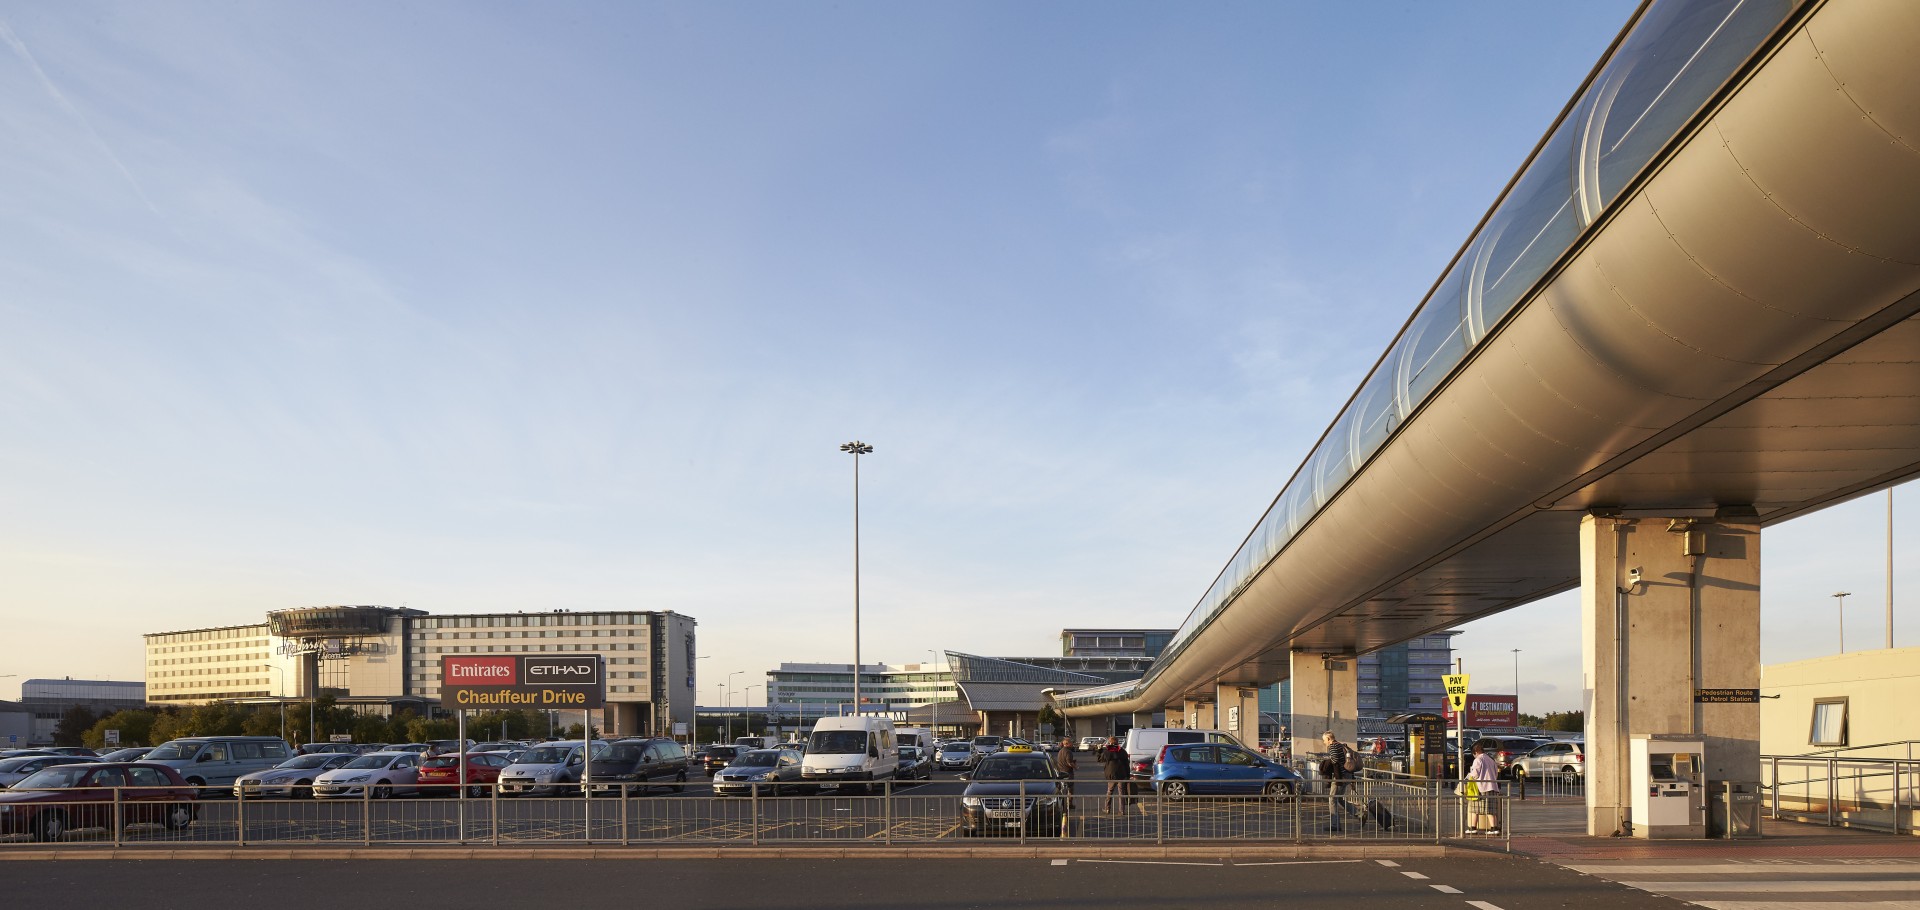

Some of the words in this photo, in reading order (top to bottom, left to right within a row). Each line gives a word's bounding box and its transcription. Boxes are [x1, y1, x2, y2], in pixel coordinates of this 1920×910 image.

[451, 664, 510, 677] Emirates
[530, 665, 591, 675] ETIHAD
[1450, 676, 1462, 685] PAY
[1448, 686, 1465, 695] HERE
[456, 690, 538, 704] Chauffeur
[543, 690, 586, 704] Drive
[1471, 702, 1477, 711] 47
[1480, 702, 1514, 712] DESTINATIONS
